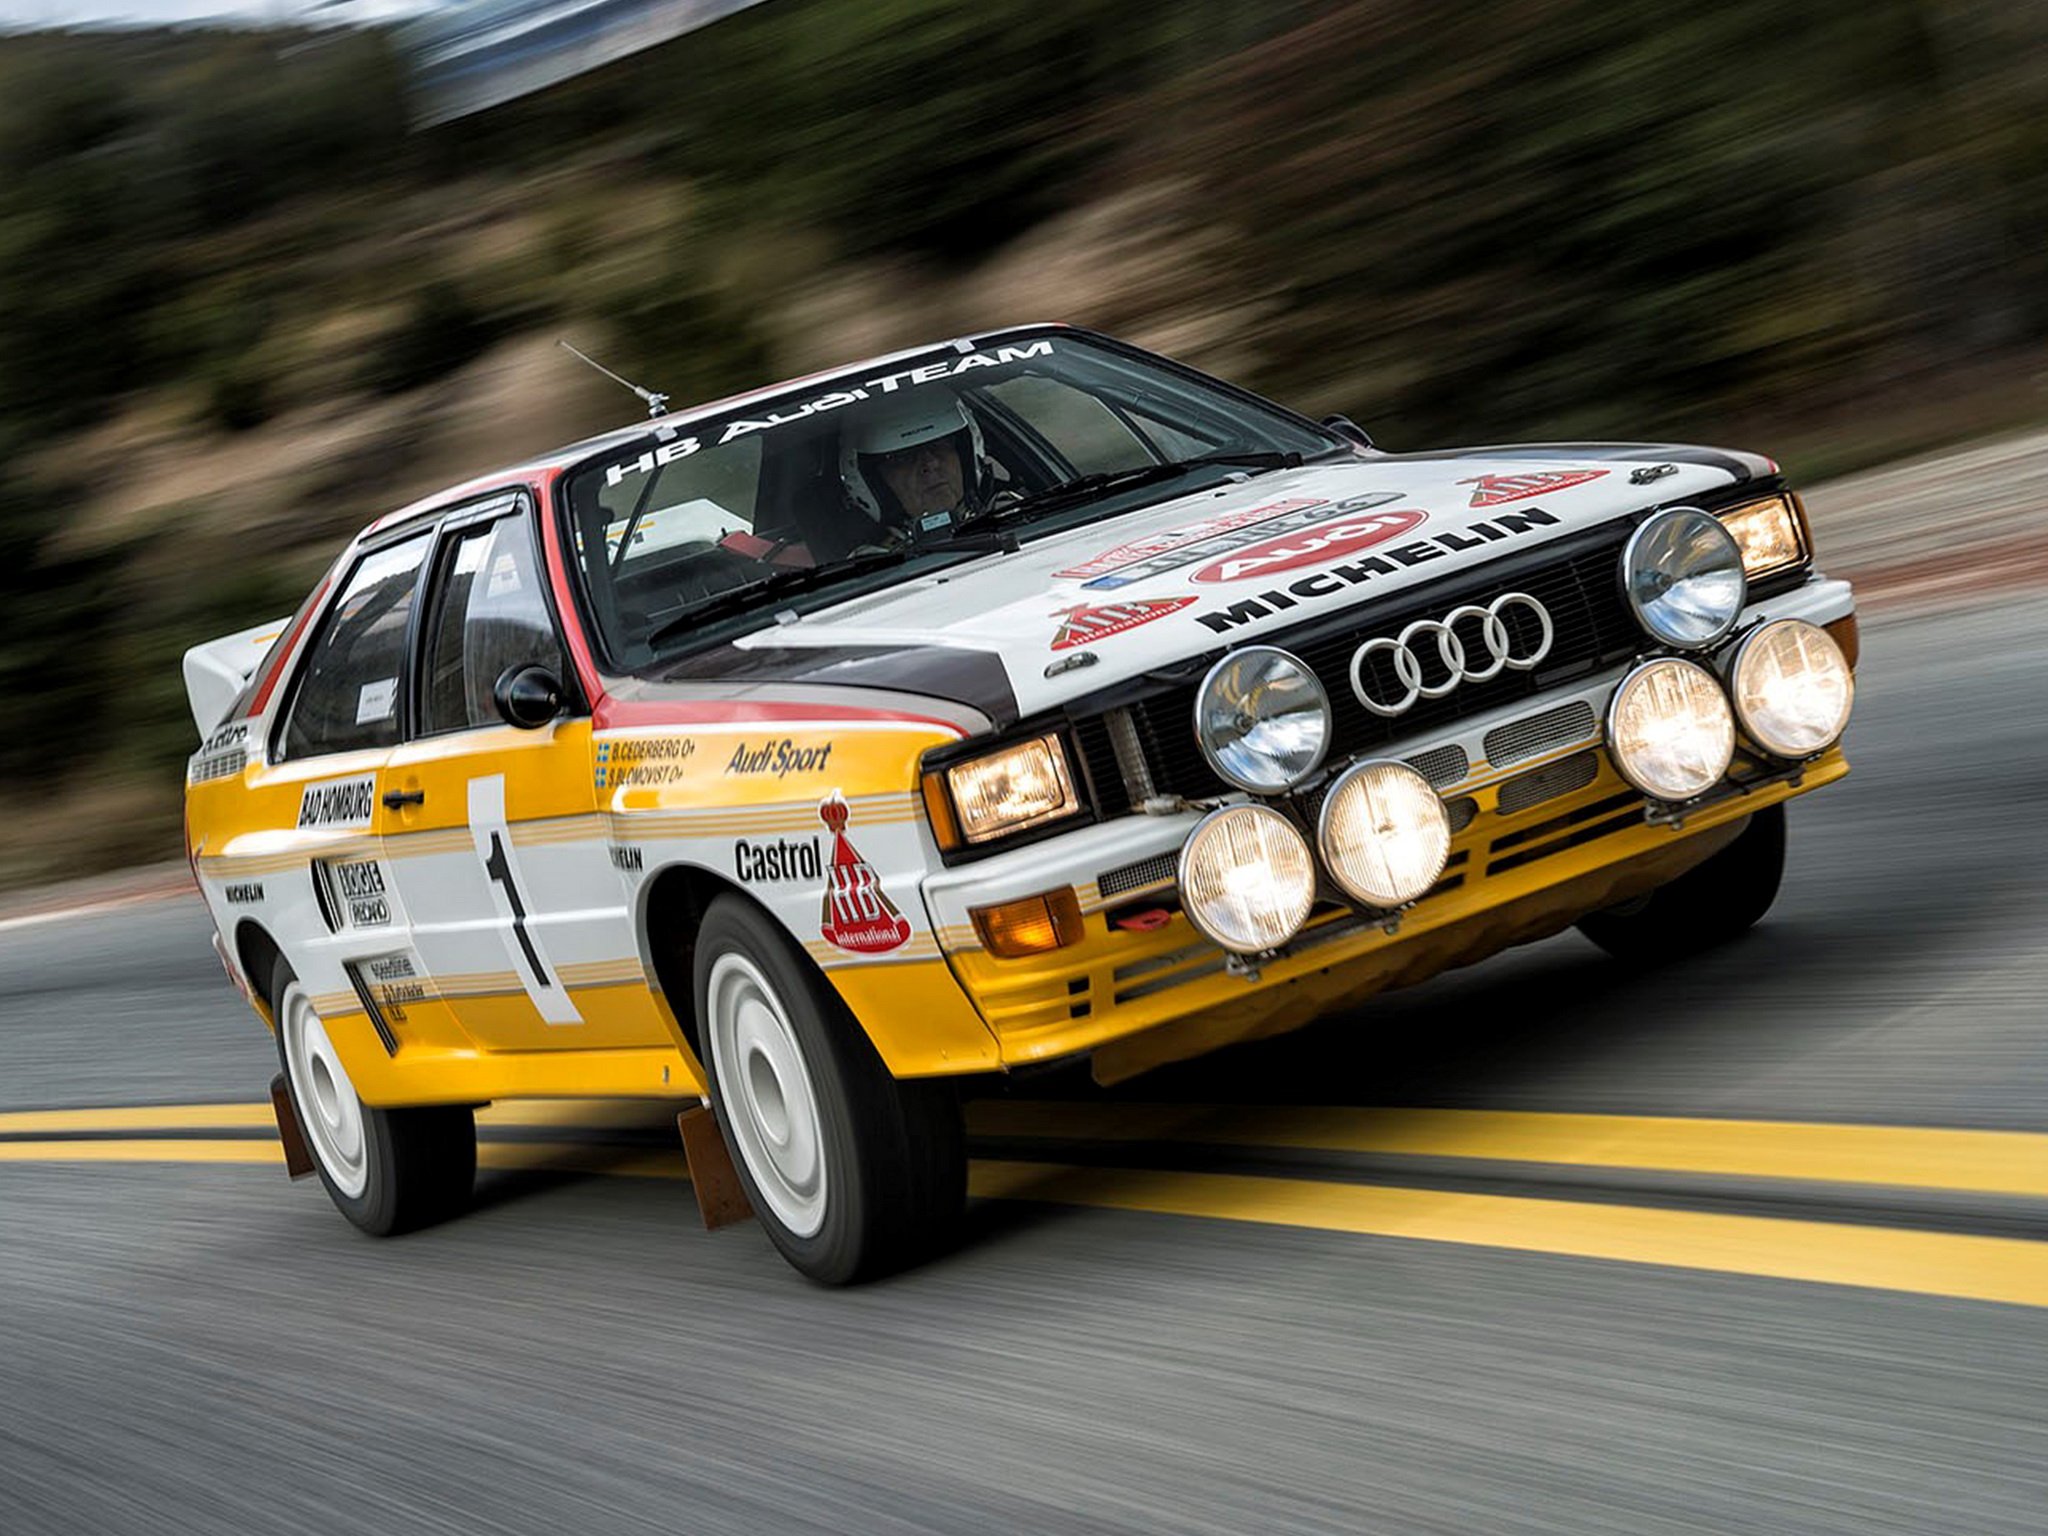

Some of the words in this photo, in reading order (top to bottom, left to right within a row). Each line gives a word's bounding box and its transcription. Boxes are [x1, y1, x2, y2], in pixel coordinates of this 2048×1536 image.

[606, 436, 701, 486] HB
[1195, 507, 1562, 634] MICHELIN
[299, 787, 322, 826] BAD
[320, 780, 373, 823] HOMBURG
[735, 836, 822, 882] Castrol
[485, 831, 552, 988] 1
[825, 862, 882, 924] HB
